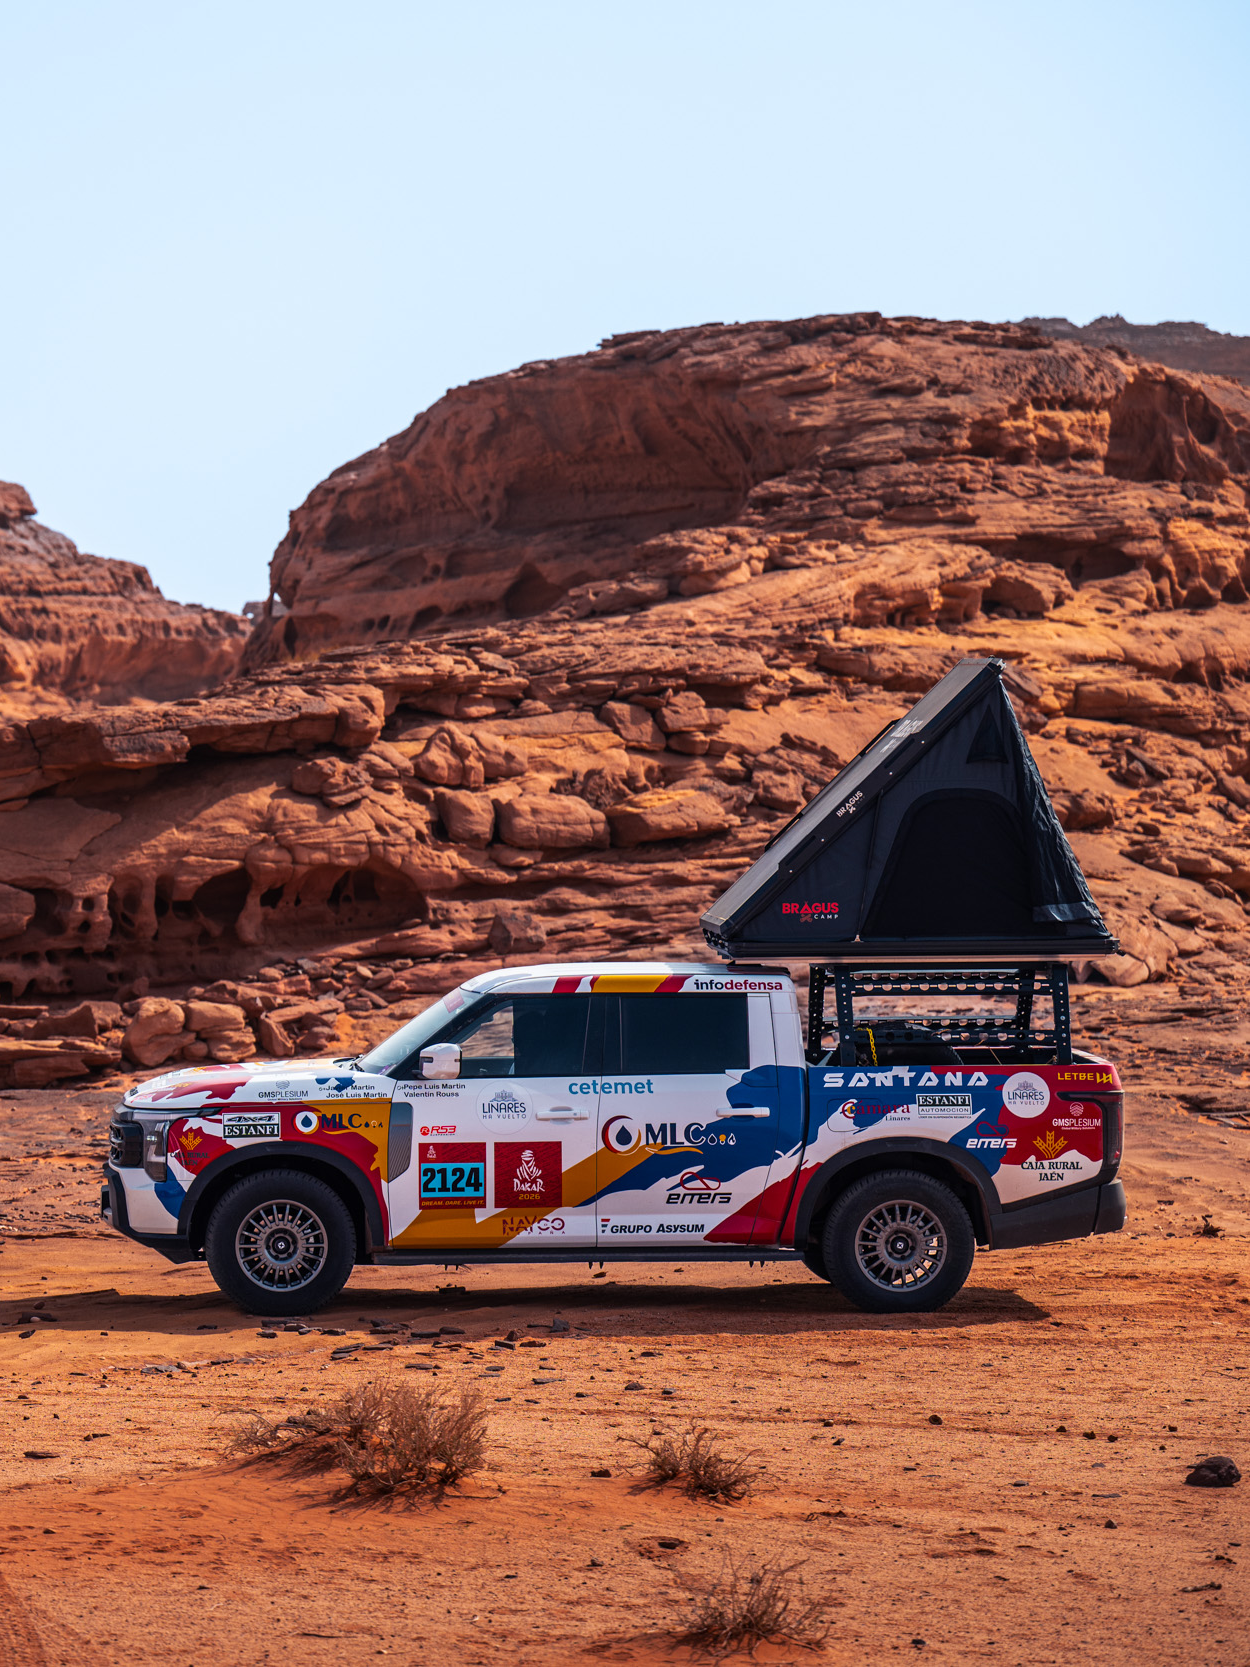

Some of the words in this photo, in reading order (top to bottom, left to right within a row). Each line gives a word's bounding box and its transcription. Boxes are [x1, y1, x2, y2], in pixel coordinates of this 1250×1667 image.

[781, 901, 840, 914] BRAGUS
[694, 979, 783, 991] infodefensa
[823, 1071, 989, 1088] SANTANA
[1057, 1072, 1094, 1081] LETBE
[403, 1083, 423, 1091] Pepe
[568, 1079, 654, 1095] cetemet
[258, 1090, 309, 1099] GMSPLESIUM
[919, 1096, 970, 1105] ESTANFI
[1007, 1091, 1045, 1101] LINARES
[482, 1102, 527, 1114] LINARES
[842, 1100, 911, 1120] Cámara
[321, 1113, 362, 1129] MLC
[1052, 1118, 1101, 1127] GMSPLESIUM
[224, 1125, 278, 1136] ESTANFI
[431, 1125, 457, 1134] RS3
[645, 1123, 707, 1145] MLC
[1021, 1161, 1046, 1170] CAJA
[1047, 1161, 1082, 1170] RURAL
[422, 1167, 483, 1193] 2124
[1039, 1170, 1064, 1182] JAÉN
[513, 1178, 546, 1193] DAKAR
[610, 1225, 652, 1234] GRUPO
